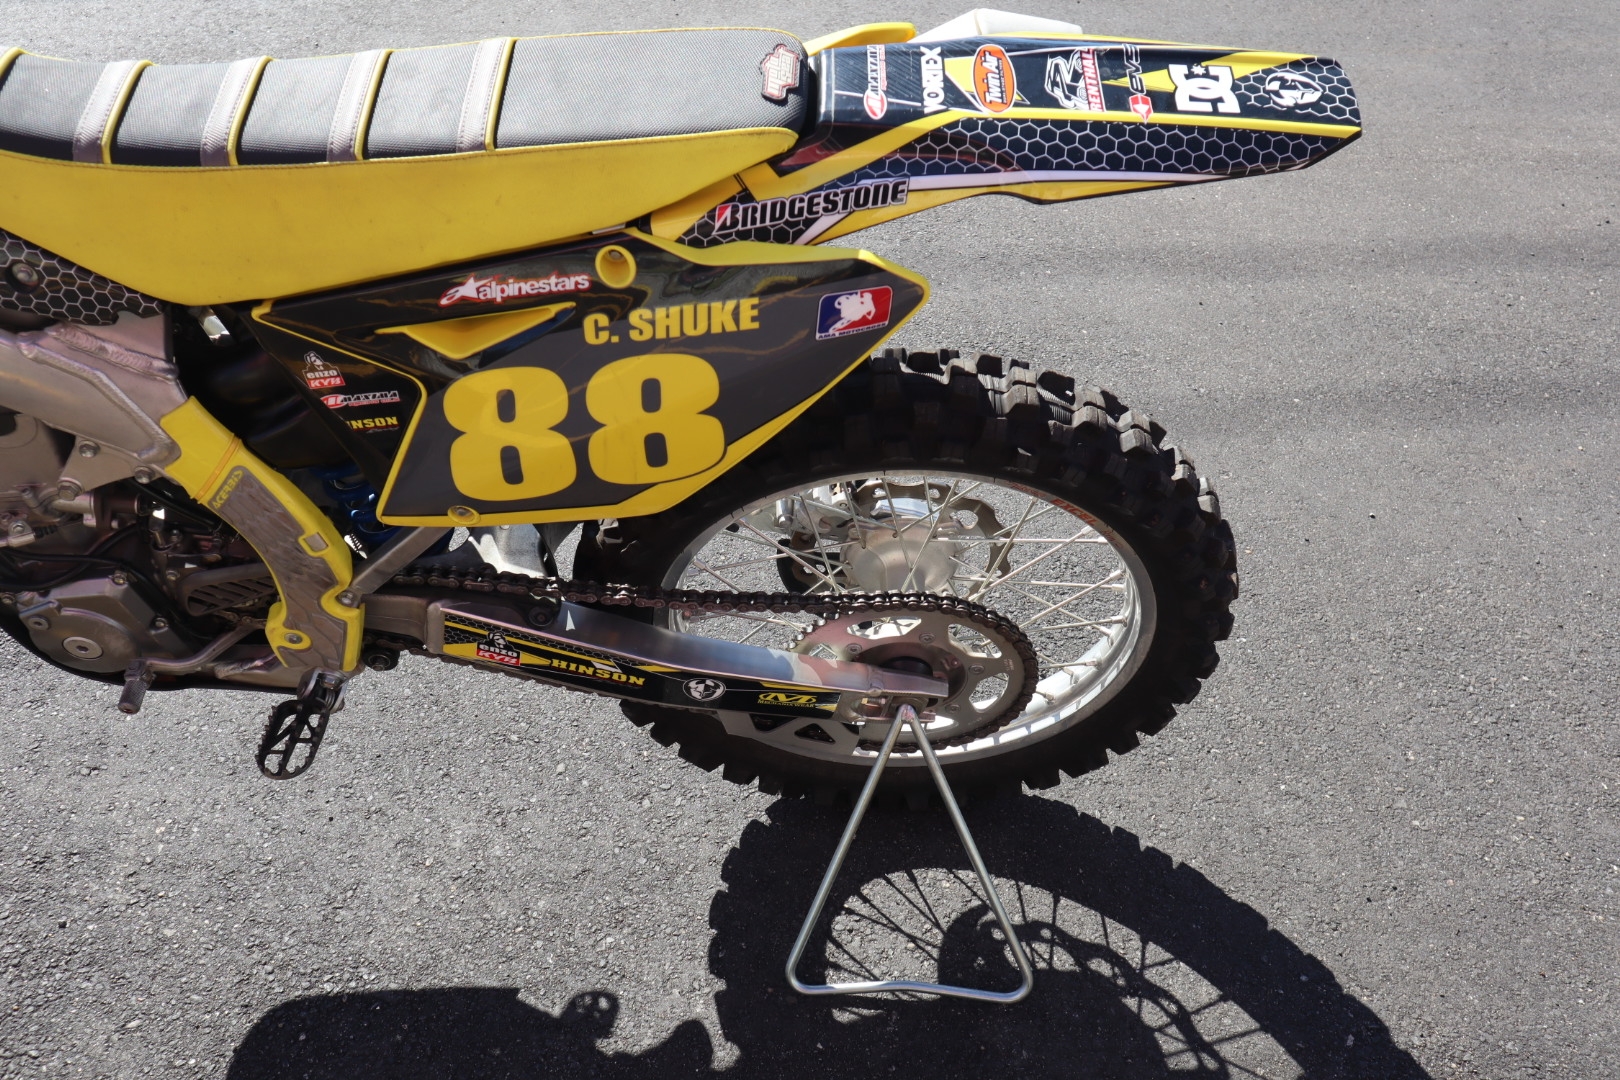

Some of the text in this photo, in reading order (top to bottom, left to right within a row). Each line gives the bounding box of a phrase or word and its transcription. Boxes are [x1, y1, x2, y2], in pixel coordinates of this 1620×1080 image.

[920, 46, 947, 114] VORTEX
[981, 51, 1002, 103] Twin Air
[1081, 48, 1103, 111] RENTHAL
[712, 178, 909, 235] BRIDGESTONE
[477, 274, 590, 302] alpinestars
[583, 297, 760, 345] C. SHUKE
[310, 377, 341, 387] KYB
[443, 353, 725, 501] 88
[212, 470, 243, 508] ACERBIS
[477, 650, 517, 664] KYB
[478, 643, 518, 657] enzo
[550, 658, 645, 686] HINSON
